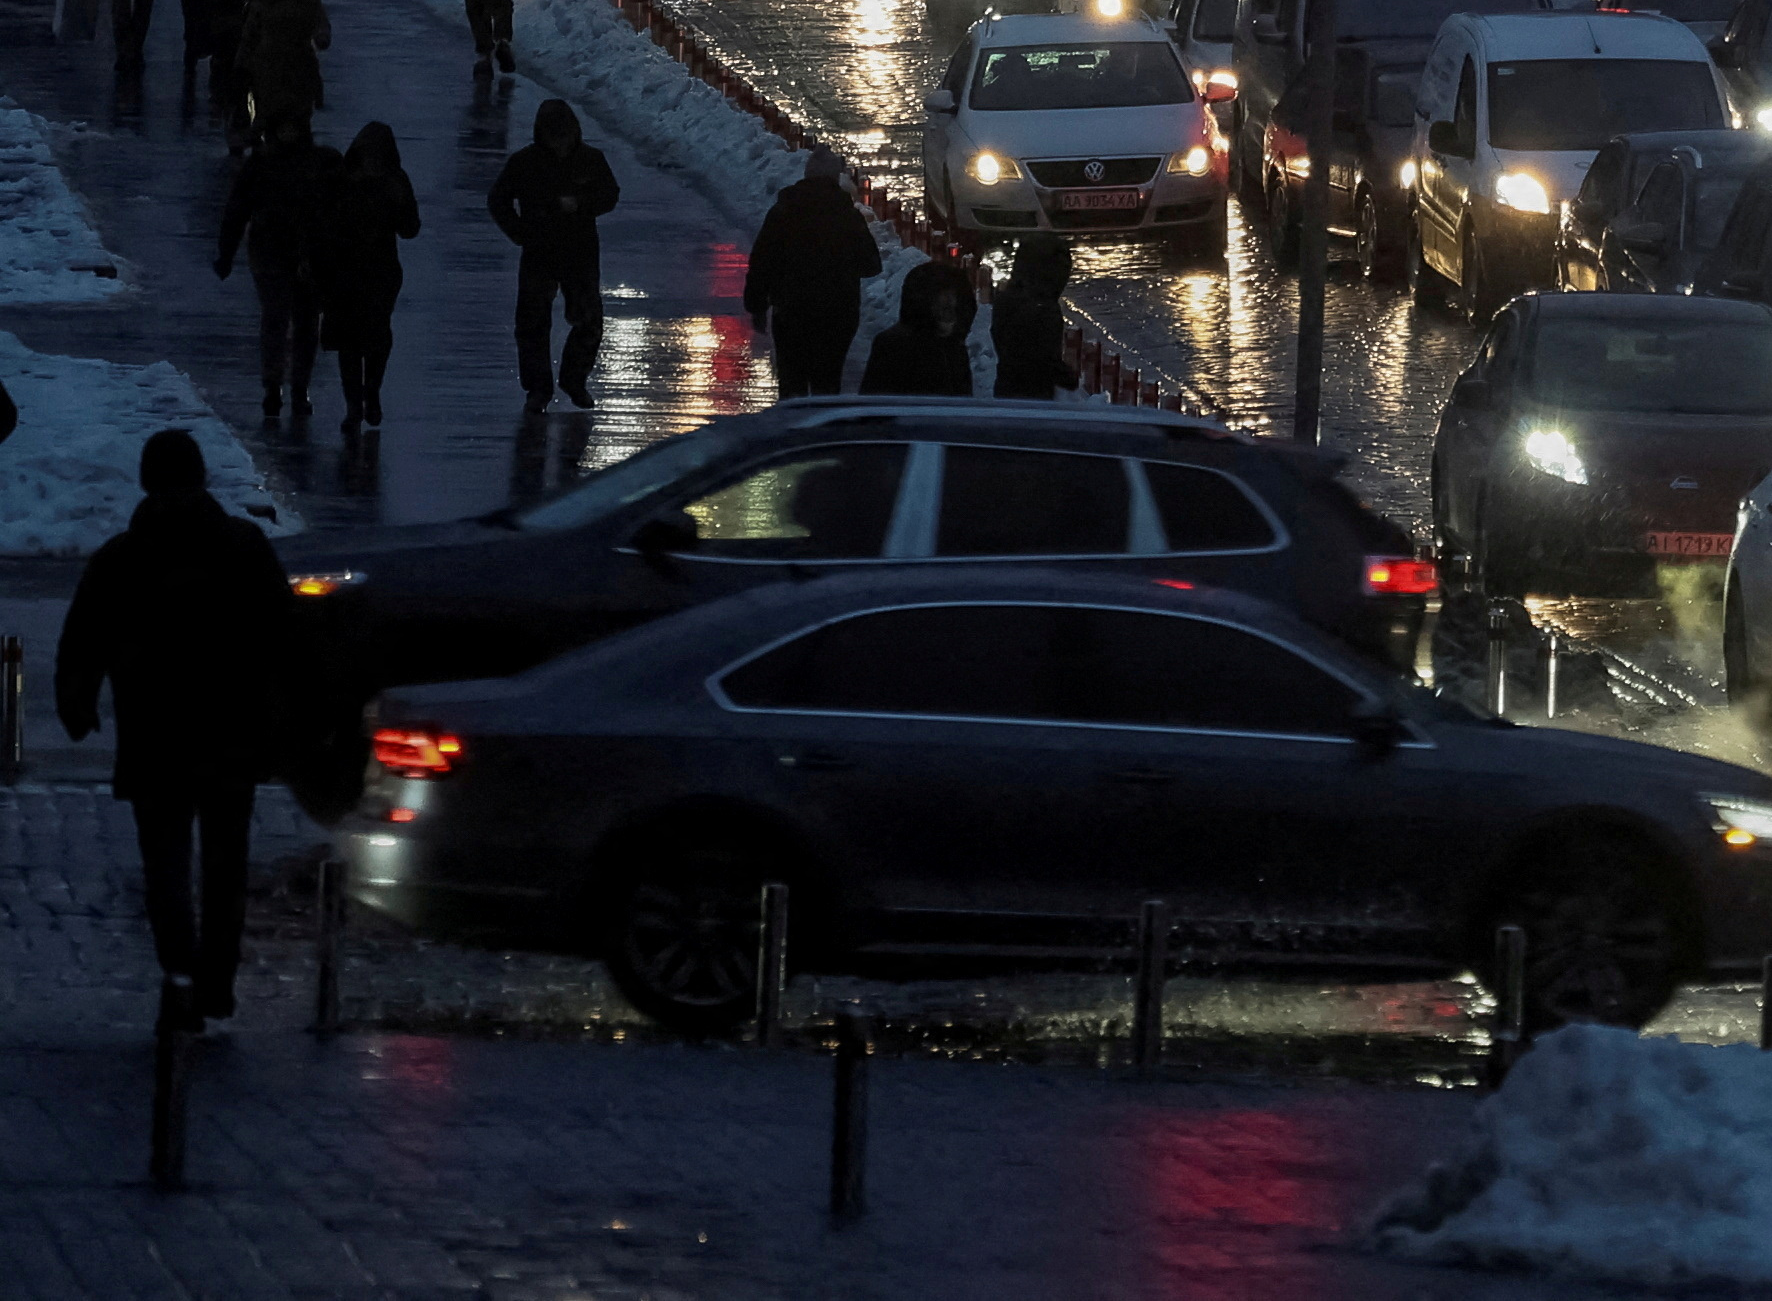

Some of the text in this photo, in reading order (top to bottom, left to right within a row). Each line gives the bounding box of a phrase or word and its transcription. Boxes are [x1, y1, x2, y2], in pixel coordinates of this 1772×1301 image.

[1064, 193, 1084, 208] AA
[1647, 535, 1730, 552] AI 1719 K
